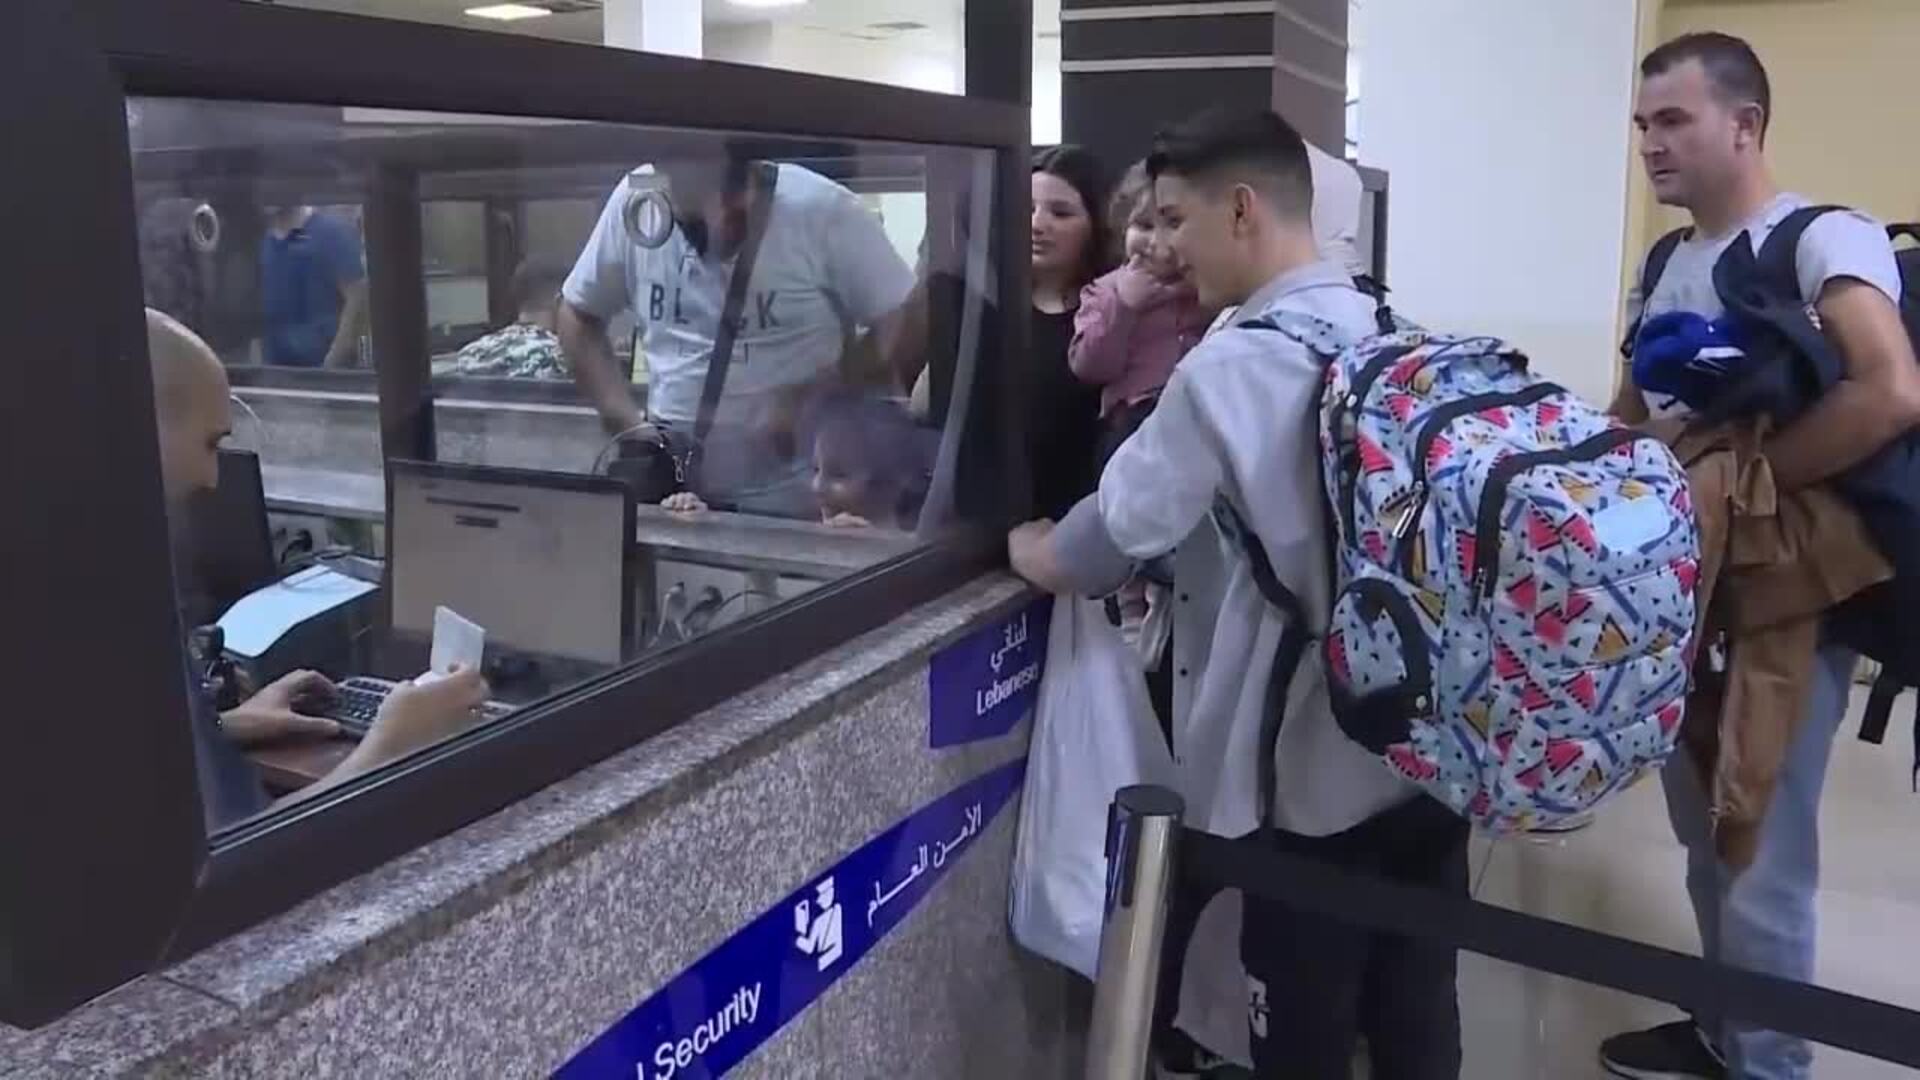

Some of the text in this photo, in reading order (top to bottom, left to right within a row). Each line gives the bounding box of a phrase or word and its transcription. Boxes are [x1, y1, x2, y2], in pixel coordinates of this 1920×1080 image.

[650, 283, 781, 330] BLK
[990, 612, 1028, 673] لبناني
[654, 981, 762, 1080] Security
